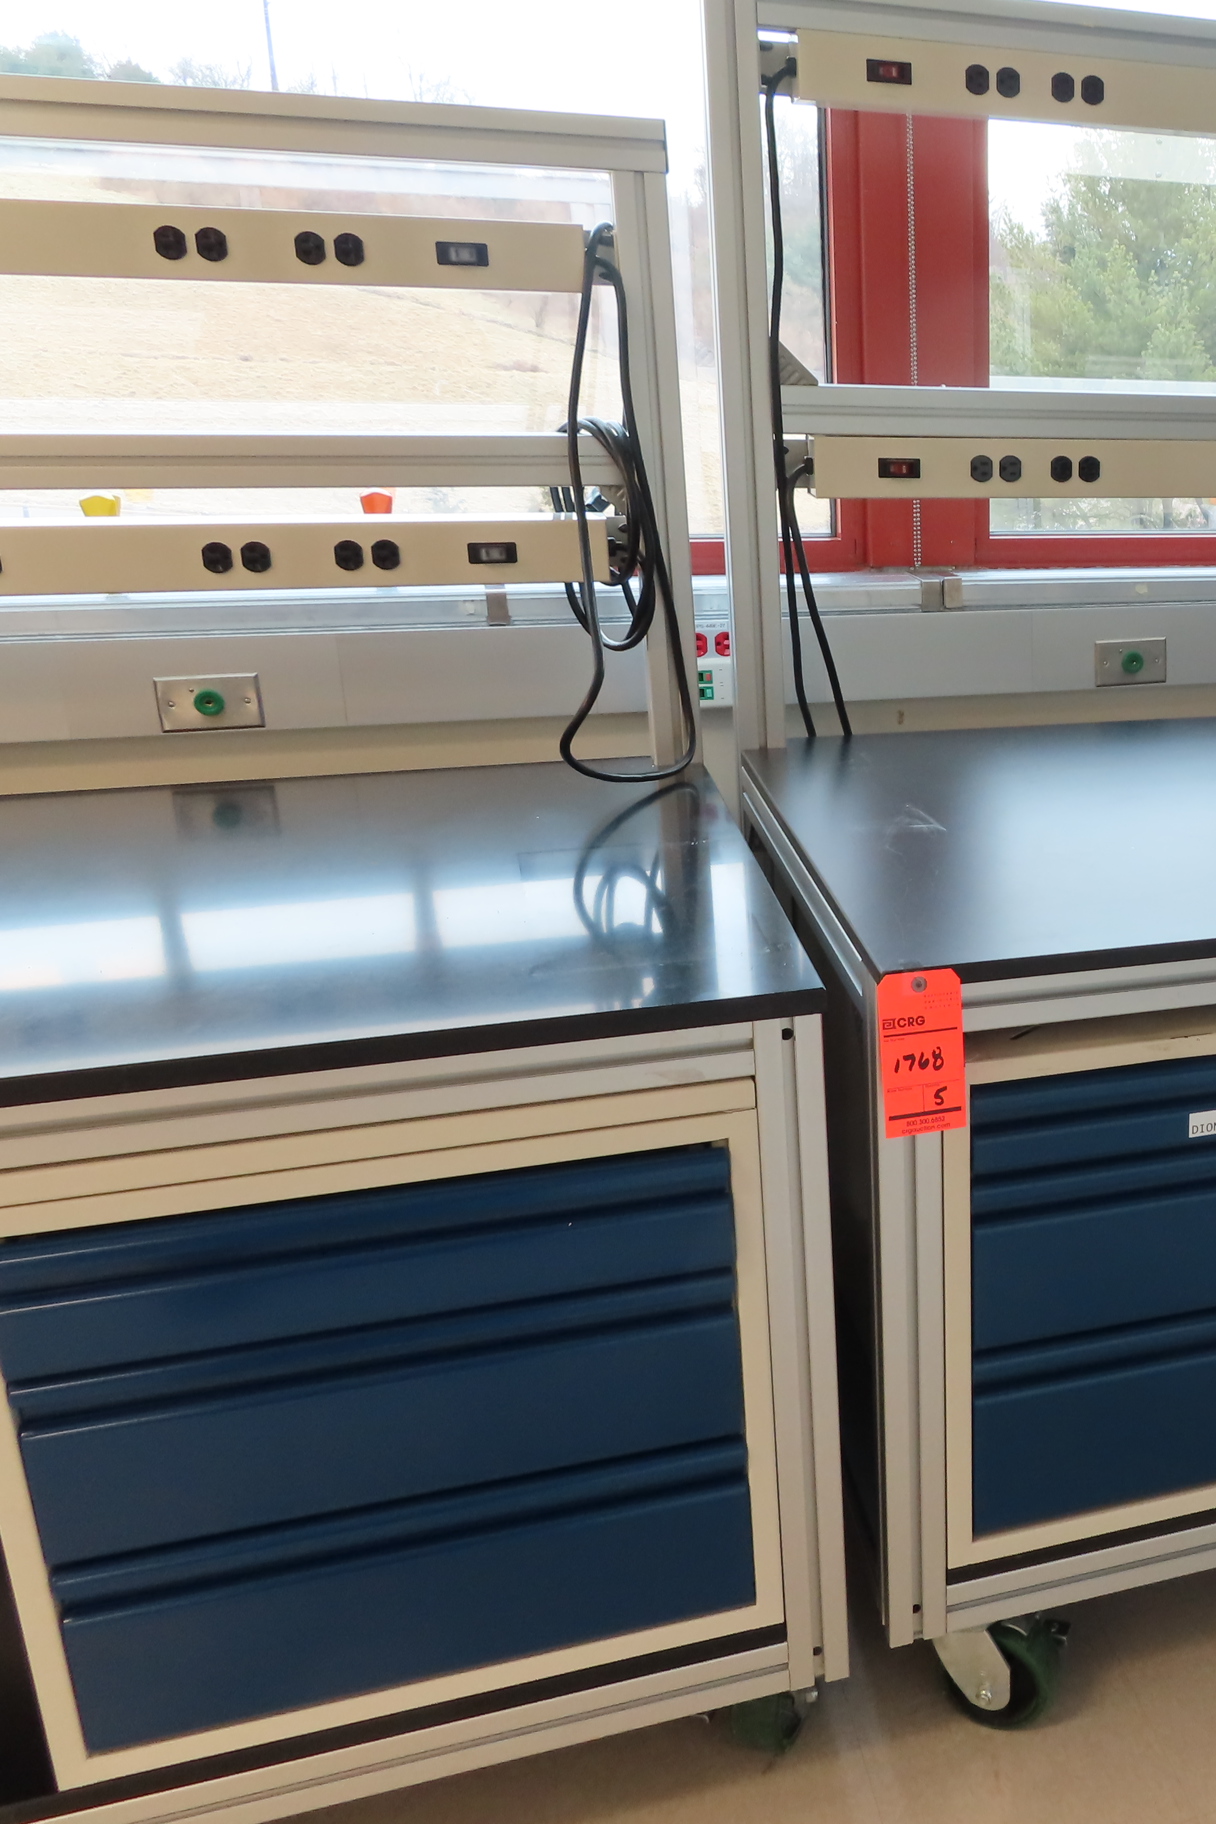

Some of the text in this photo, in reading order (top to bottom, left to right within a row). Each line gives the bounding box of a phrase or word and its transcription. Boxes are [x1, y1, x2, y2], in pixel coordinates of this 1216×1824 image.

[897, 1015, 926, 1028] CRG
[894, 1046, 945, 1073] 1768
[933, 1085, 948, 1106] 5
